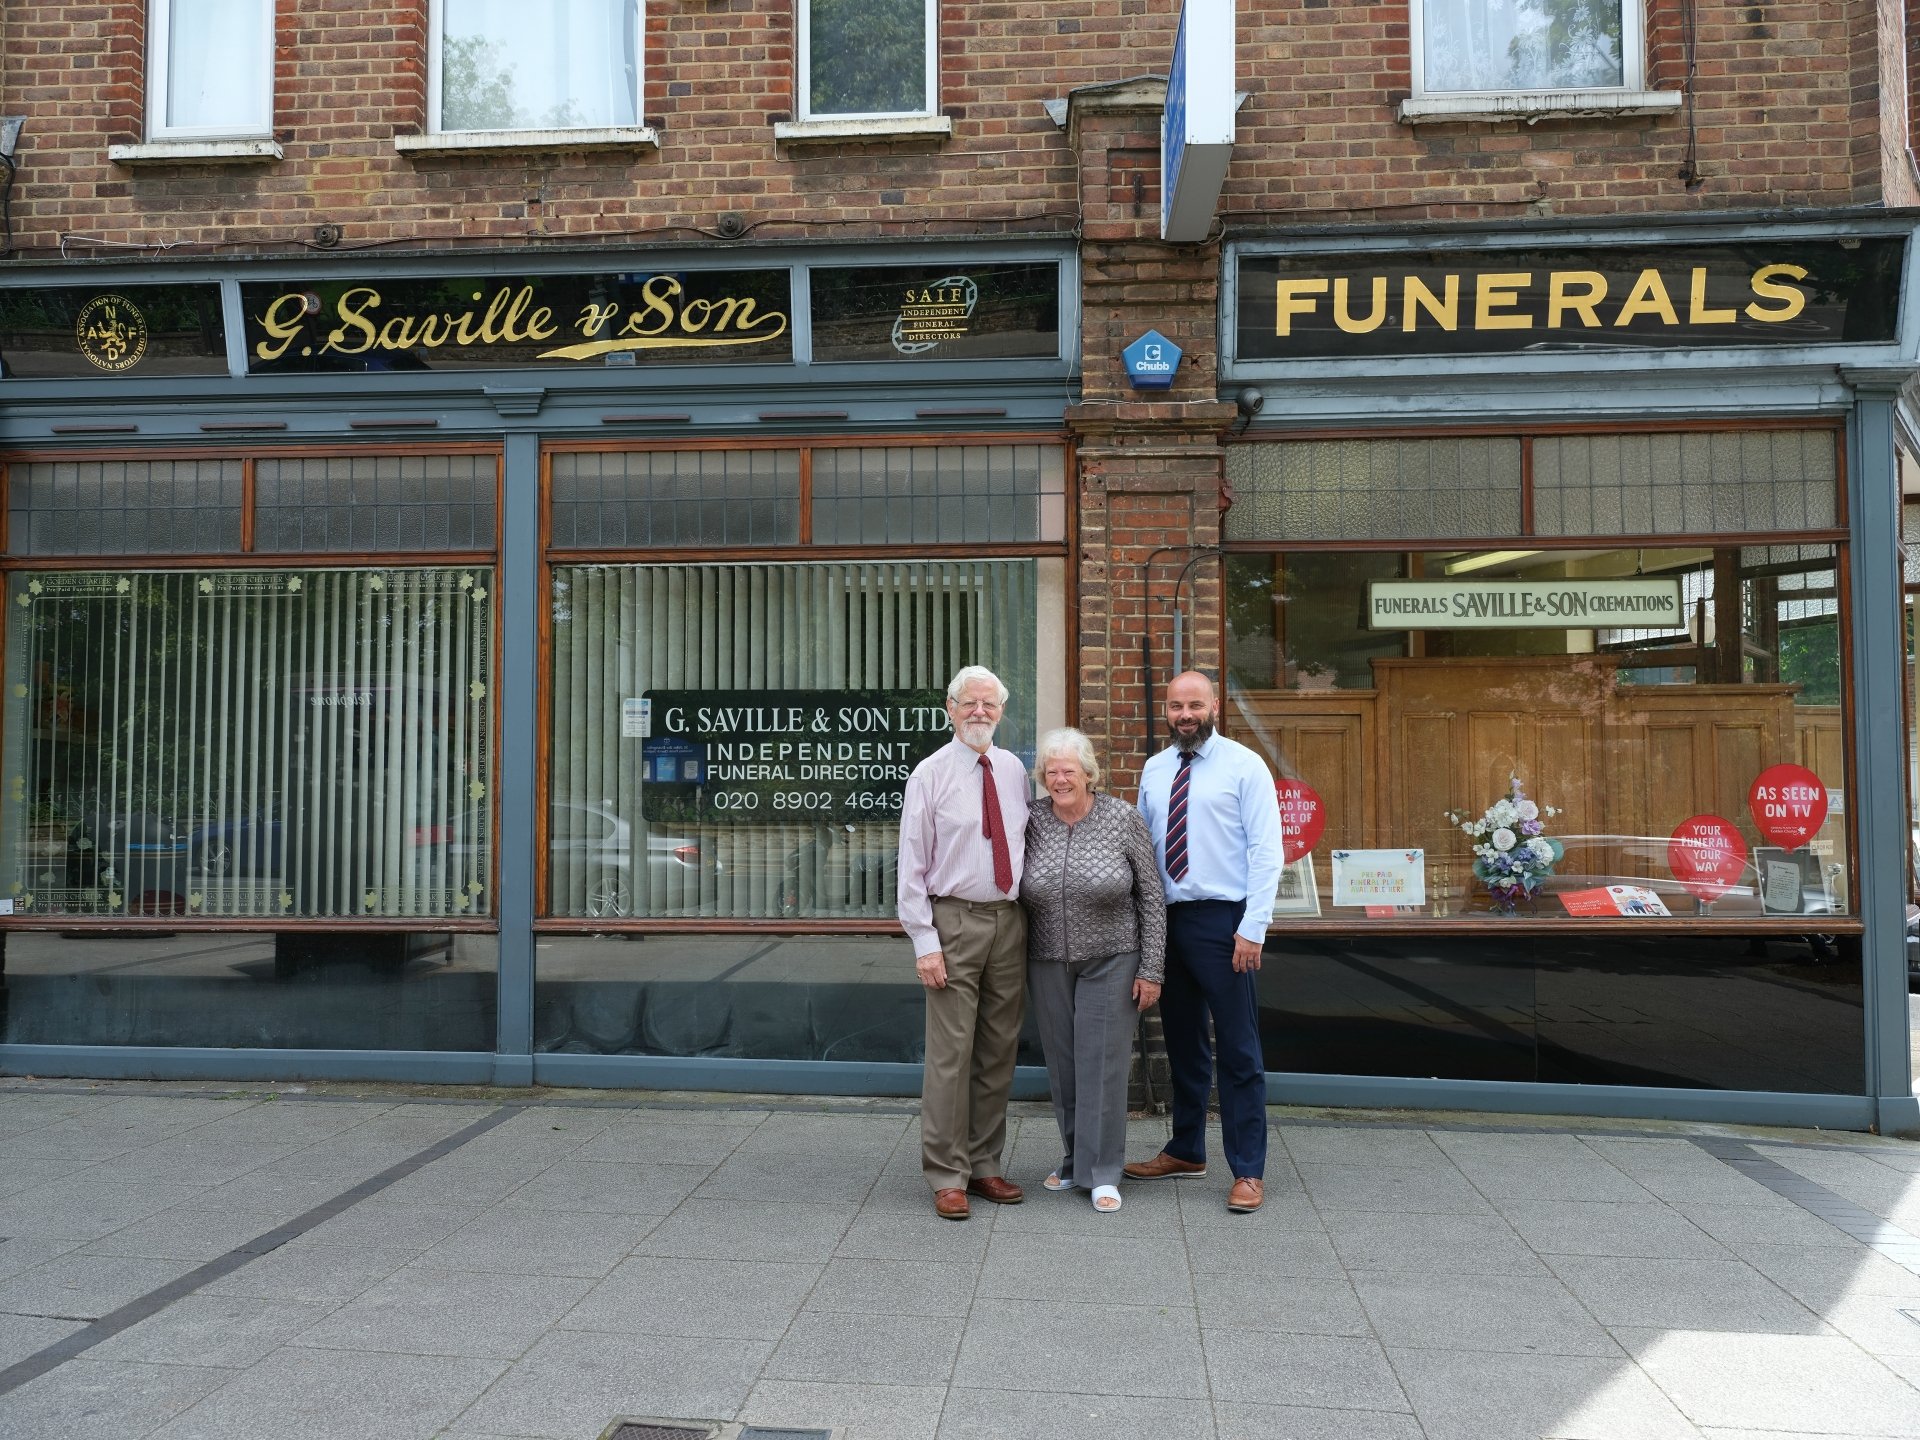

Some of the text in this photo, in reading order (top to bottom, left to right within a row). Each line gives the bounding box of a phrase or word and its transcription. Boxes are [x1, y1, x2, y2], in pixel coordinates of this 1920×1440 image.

[619, 275, 787, 339] Son
[1275, 264, 1809, 337] FUNERALS
[105, 306, 116, 319] N
[903, 308, 966, 317] INDEPENDENT
[913, 320, 955, 328] FUNERAL
[908, 332, 961, 341] DIRECTORS
[107, 347, 118, 360] D
[1135, 361, 1170, 371] Chubb
[1375, 597, 1448, 614] FUNERALS
[1589, 595, 1674, 612] CREMATIONS
[664, 707, 690, 733] G.
[697, 707, 804, 733] SAVILLE
[811, 708, 832, 732] &
[838, 707, 890, 732] SON
[707, 743, 911, 761] INDEPENDENT
[707, 765, 795, 780] FUNERAL
[800, 764, 910, 780] DIRECTORS
[1756, 787, 1820, 800] AS SEEN
[714, 791, 903, 810] 020 8902 4643
[1297, 801, 1317, 811] FOR
[1765, 804, 1812, 818] ON TV
[1300, 813, 1312, 823] OF
[1282, 825, 1301, 835] IND
[1692, 825, 1721, 835] YOUR
[1692, 849, 1721, 860] YOUR
[1695, 861, 1719, 872] WAY
